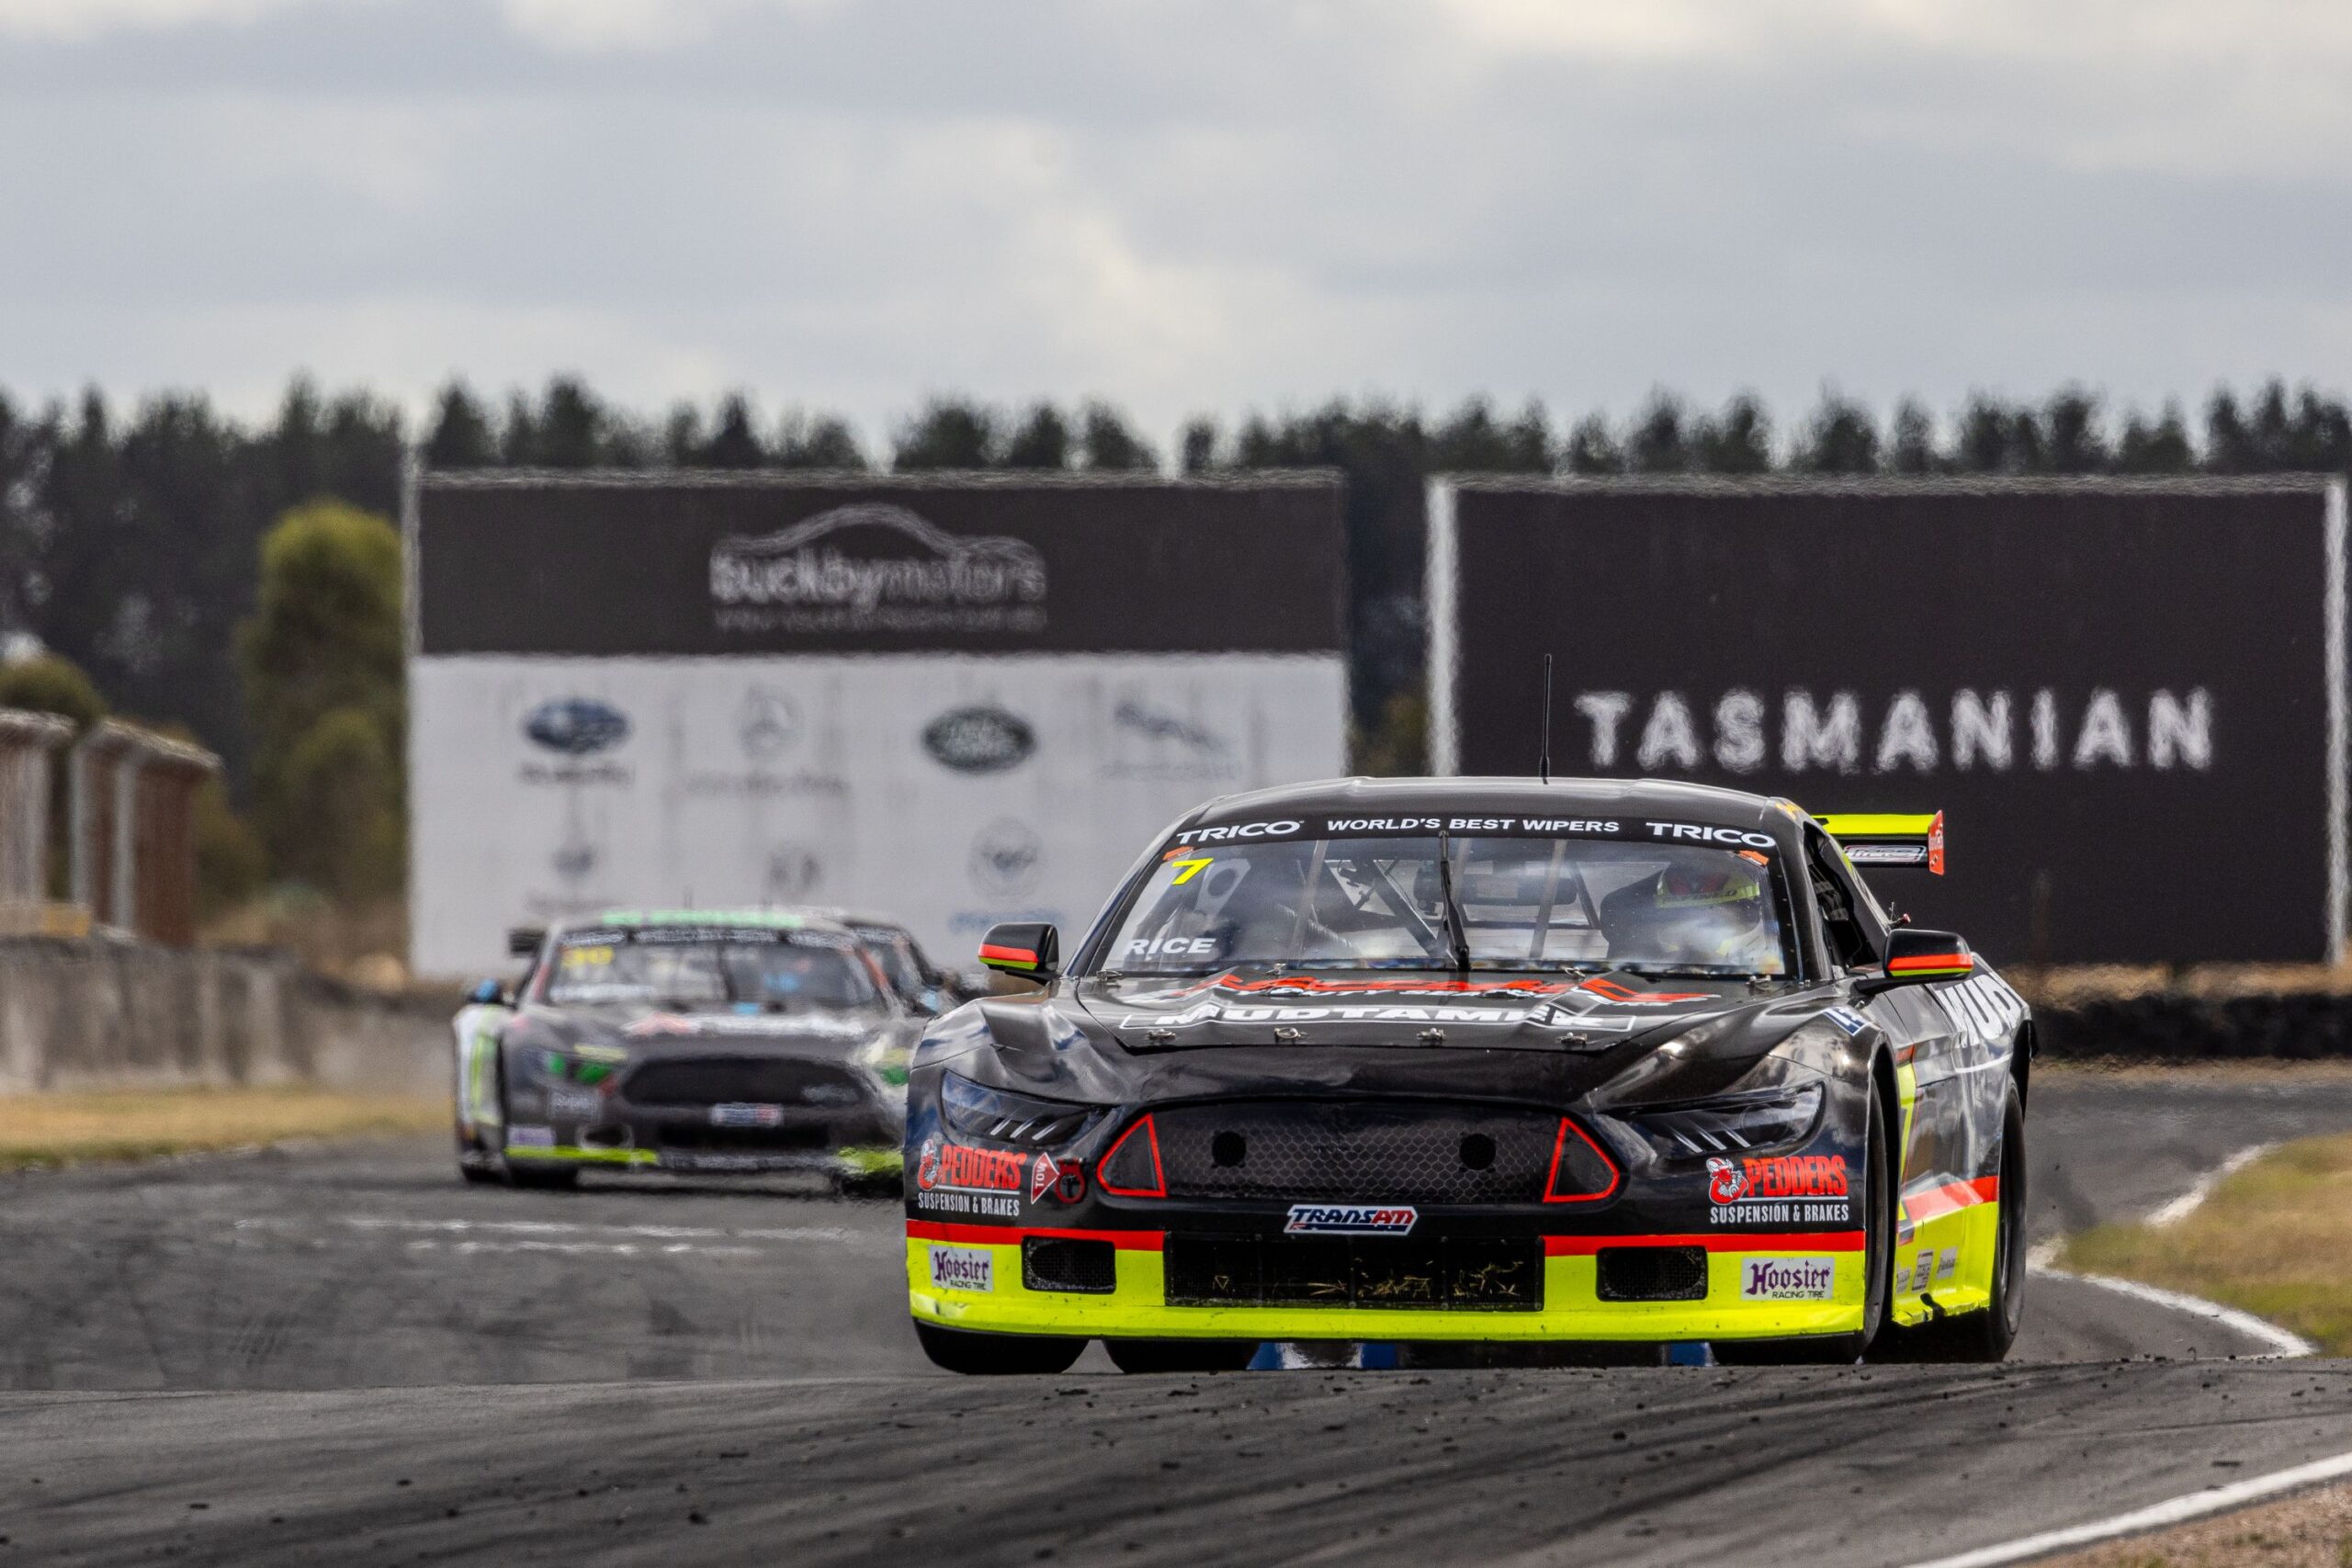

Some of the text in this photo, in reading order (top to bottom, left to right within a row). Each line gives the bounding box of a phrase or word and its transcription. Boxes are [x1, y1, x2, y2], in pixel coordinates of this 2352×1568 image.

[1573, 689, 2211, 772] TASMANIAN
[1177, 820, 1301, 844] TRICO
[1327, 818, 1620, 832] WORLD'S BEST WIPERS
[1645, 822, 1777, 848] TRICO
[1171, 858, 1214, 886] 7
[1121, 938, 1216, 956] RICE
[1154, 1005, 1604, 1026] MUDTAMER
[940, 1144, 1027, 1190] PEDDERS
[1035, 1160, 1049, 1189] TOW
[1742, 1155, 1849, 1197] PEDDERS
[919, 1192, 1021, 1216] SUSPENSION & BRAKES
[1710, 1204, 1849, 1224] SUSPENSION & BRAKES
[934, 1250, 989, 1281] Hoosier
[1745, 1259, 1831, 1295] Hoosier
[950, 1280, 987, 1291] RACING TIRE
[1772, 1291, 1825, 1299] RACING TIRE
